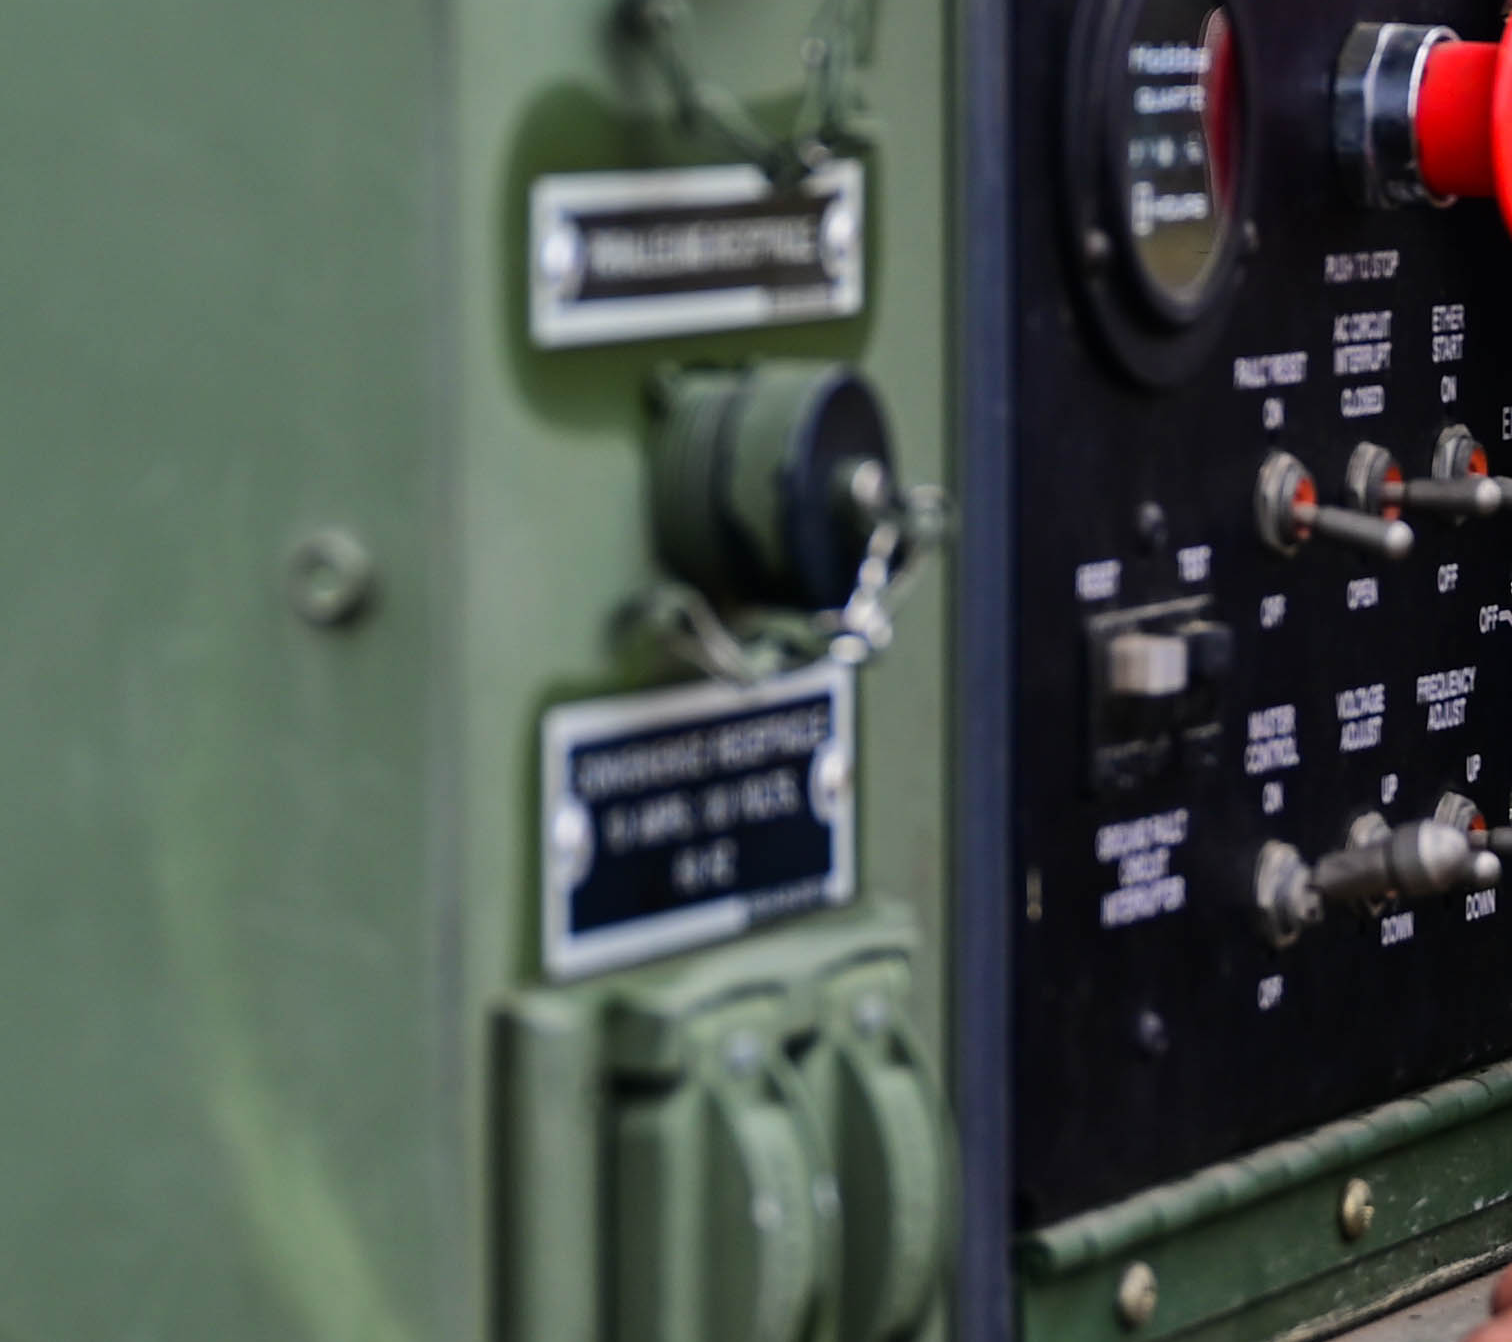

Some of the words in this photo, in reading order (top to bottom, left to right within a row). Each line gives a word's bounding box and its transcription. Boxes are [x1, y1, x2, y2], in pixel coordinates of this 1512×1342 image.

[1431, 304, 1465, 334] ETHER
[1431, 333, 1464, 363] START
[1340, 384, 1386, 418] CLOSED
[1440, 375, 1457, 404] ON
[1346, 576, 1378, 611] OPEN
[1437, 563, 1459, 593] OFF
[1479, 603, 1500, 635] OFF
[1416, 665, 1477, 705] FREQUENCY
[1336, 683, 1385, 722] VOLTAGE
[1426, 696, 1467, 732] ADJUST
[1339, 715, 1383, 753] ADJUST
[1466, 753, 1482, 783] UP
[1380, 773, 1399, 805] UP
[1465, 888, 1496, 922] DOWN
[1381, 911, 1415, 946] DOWN
